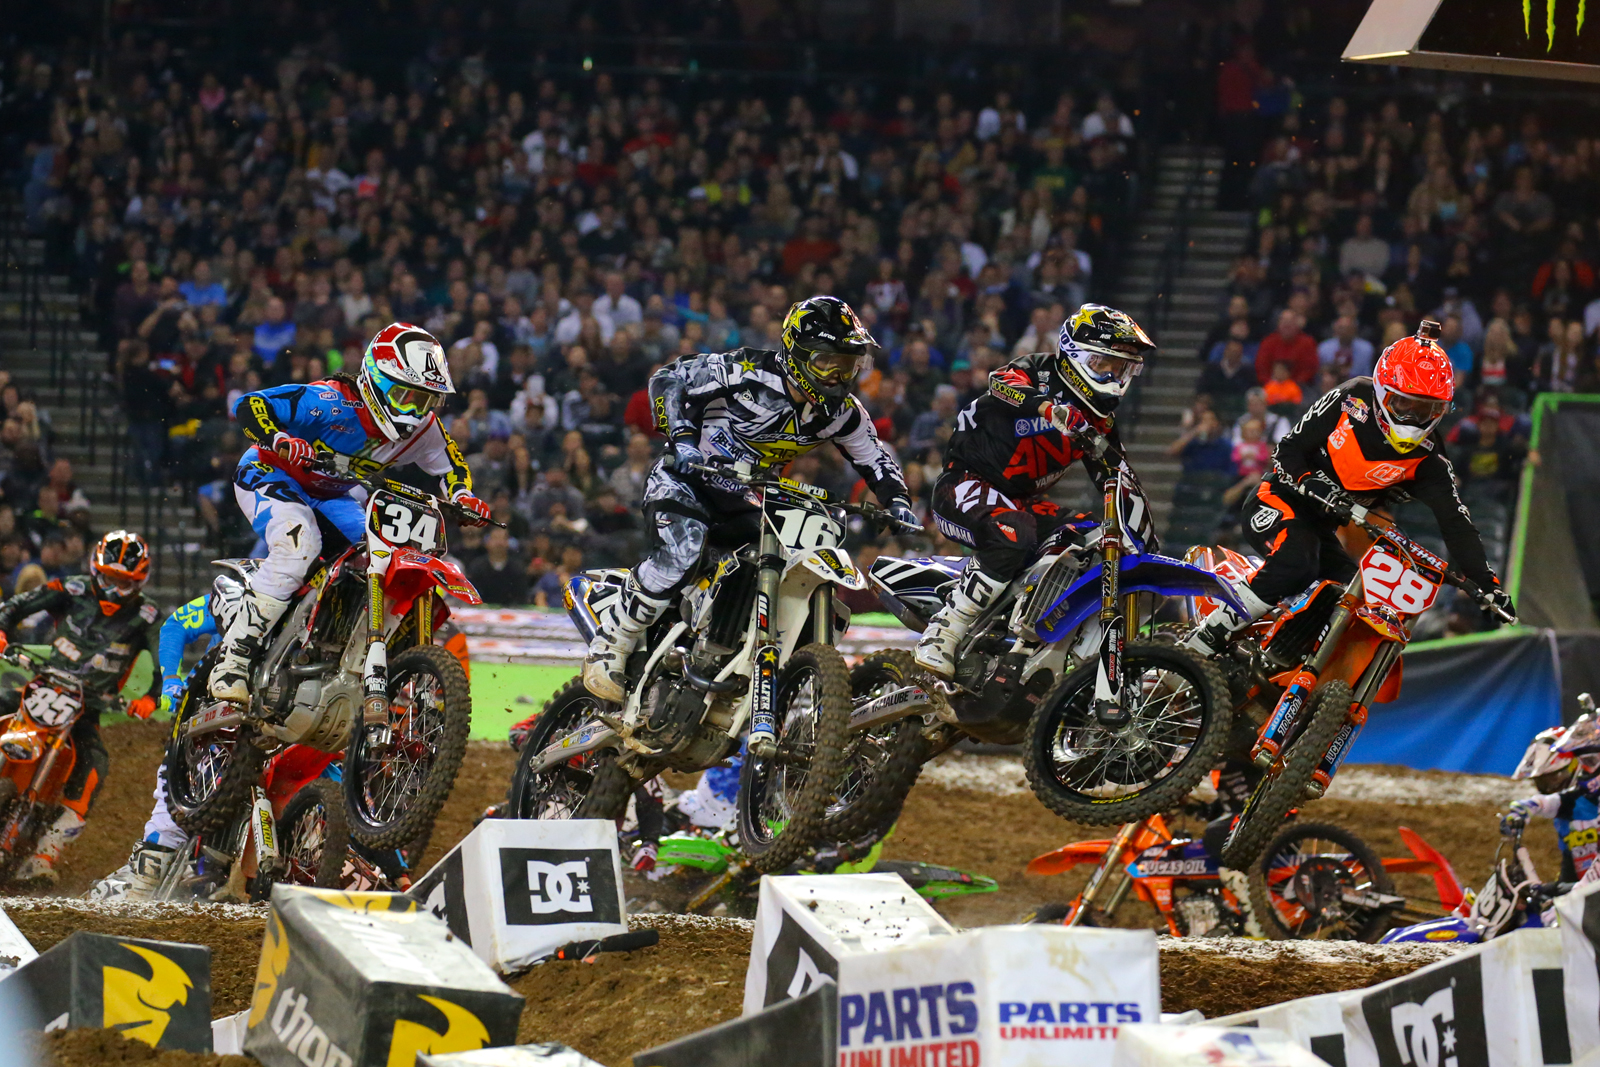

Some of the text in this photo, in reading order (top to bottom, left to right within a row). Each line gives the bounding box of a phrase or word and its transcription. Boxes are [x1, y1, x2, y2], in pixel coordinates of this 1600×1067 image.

[991, 380, 1026, 403] ROCKSTAR
[381, 503, 438, 553] 34
[775, 509, 841, 549] 16
[1363, 552, 1434, 614] 28
[1183, 858, 1206, 875] OIL
[527, 860, 593, 914] DC
[840, 981, 979, 1046] PARTS
[1000, 1002, 1141, 1023] PARTS
[1000, 1026, 1119, 1040] UNLIMIT
